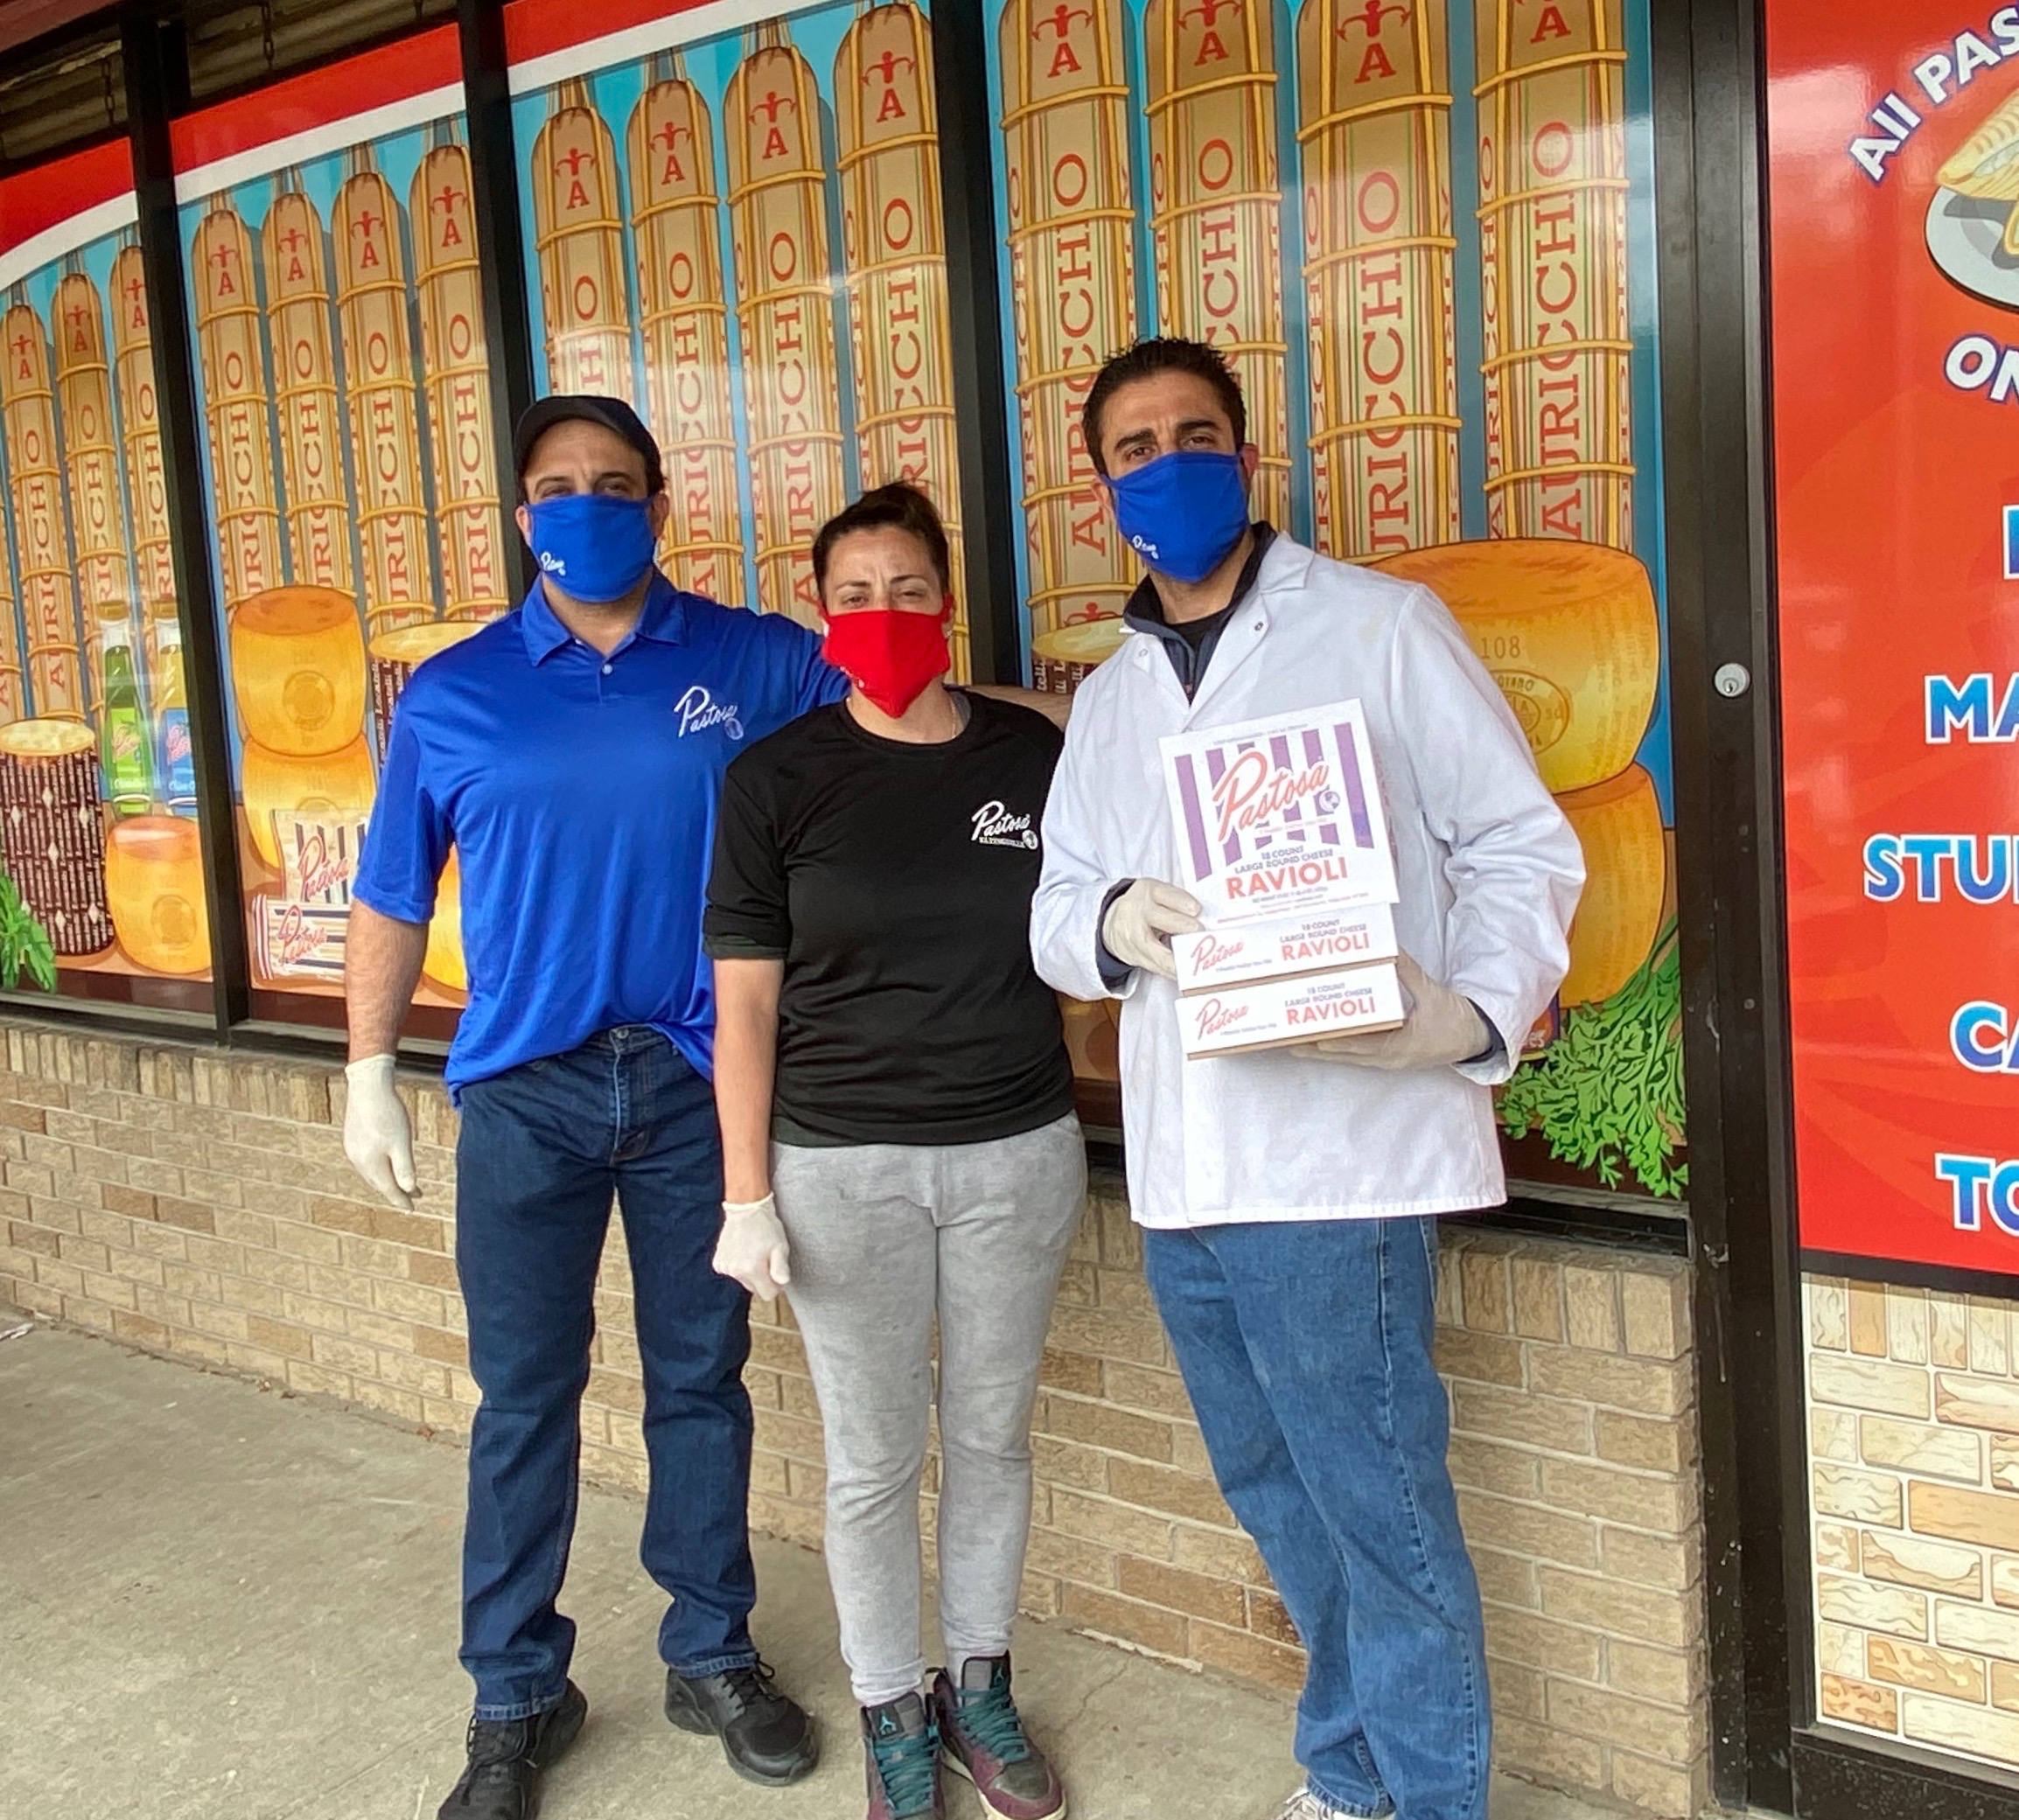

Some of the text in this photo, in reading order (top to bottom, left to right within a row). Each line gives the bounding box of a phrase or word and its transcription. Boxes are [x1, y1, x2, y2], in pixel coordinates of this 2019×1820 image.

[1531, 6, 1571, 44] A
[1047, 42, 1082, 78] A
[1194, 31, 1229, 66] A
[1354, 42, 1396, 84] A
[877, 88, 905, 122] A
[762, 128, 789, 160] A
[1848, 91, 1922, 181] All
[660, 155, 686, 185] A
[566, 179, 590, 210] A
[442, 219, 462, 248] A
[287, 257, 305, 282] A
[360, 241, 380, 268] A
[218, 272, 236, 296] A
[132, 304, 146, 329] A
[74, 330, 88, 352] A
[18, 359, 32, 380] A
[24, 429, 66, 689] AURICCHO
[1212, 751, 1330, 841] Pastosa
[1234, 861, 1264, 875] LARGE
[1266, 855, 1301, 868] ROUND
[1272, 845, 1304, 858] COUNT
[1226, 856, 1348, 900] RAVIOLI
[1862, 833, 2019, 904] STU
[1282, 932, 1370, 961] RAVIOLI
[1287, 996, 1376, 1025] RAVIOLI
